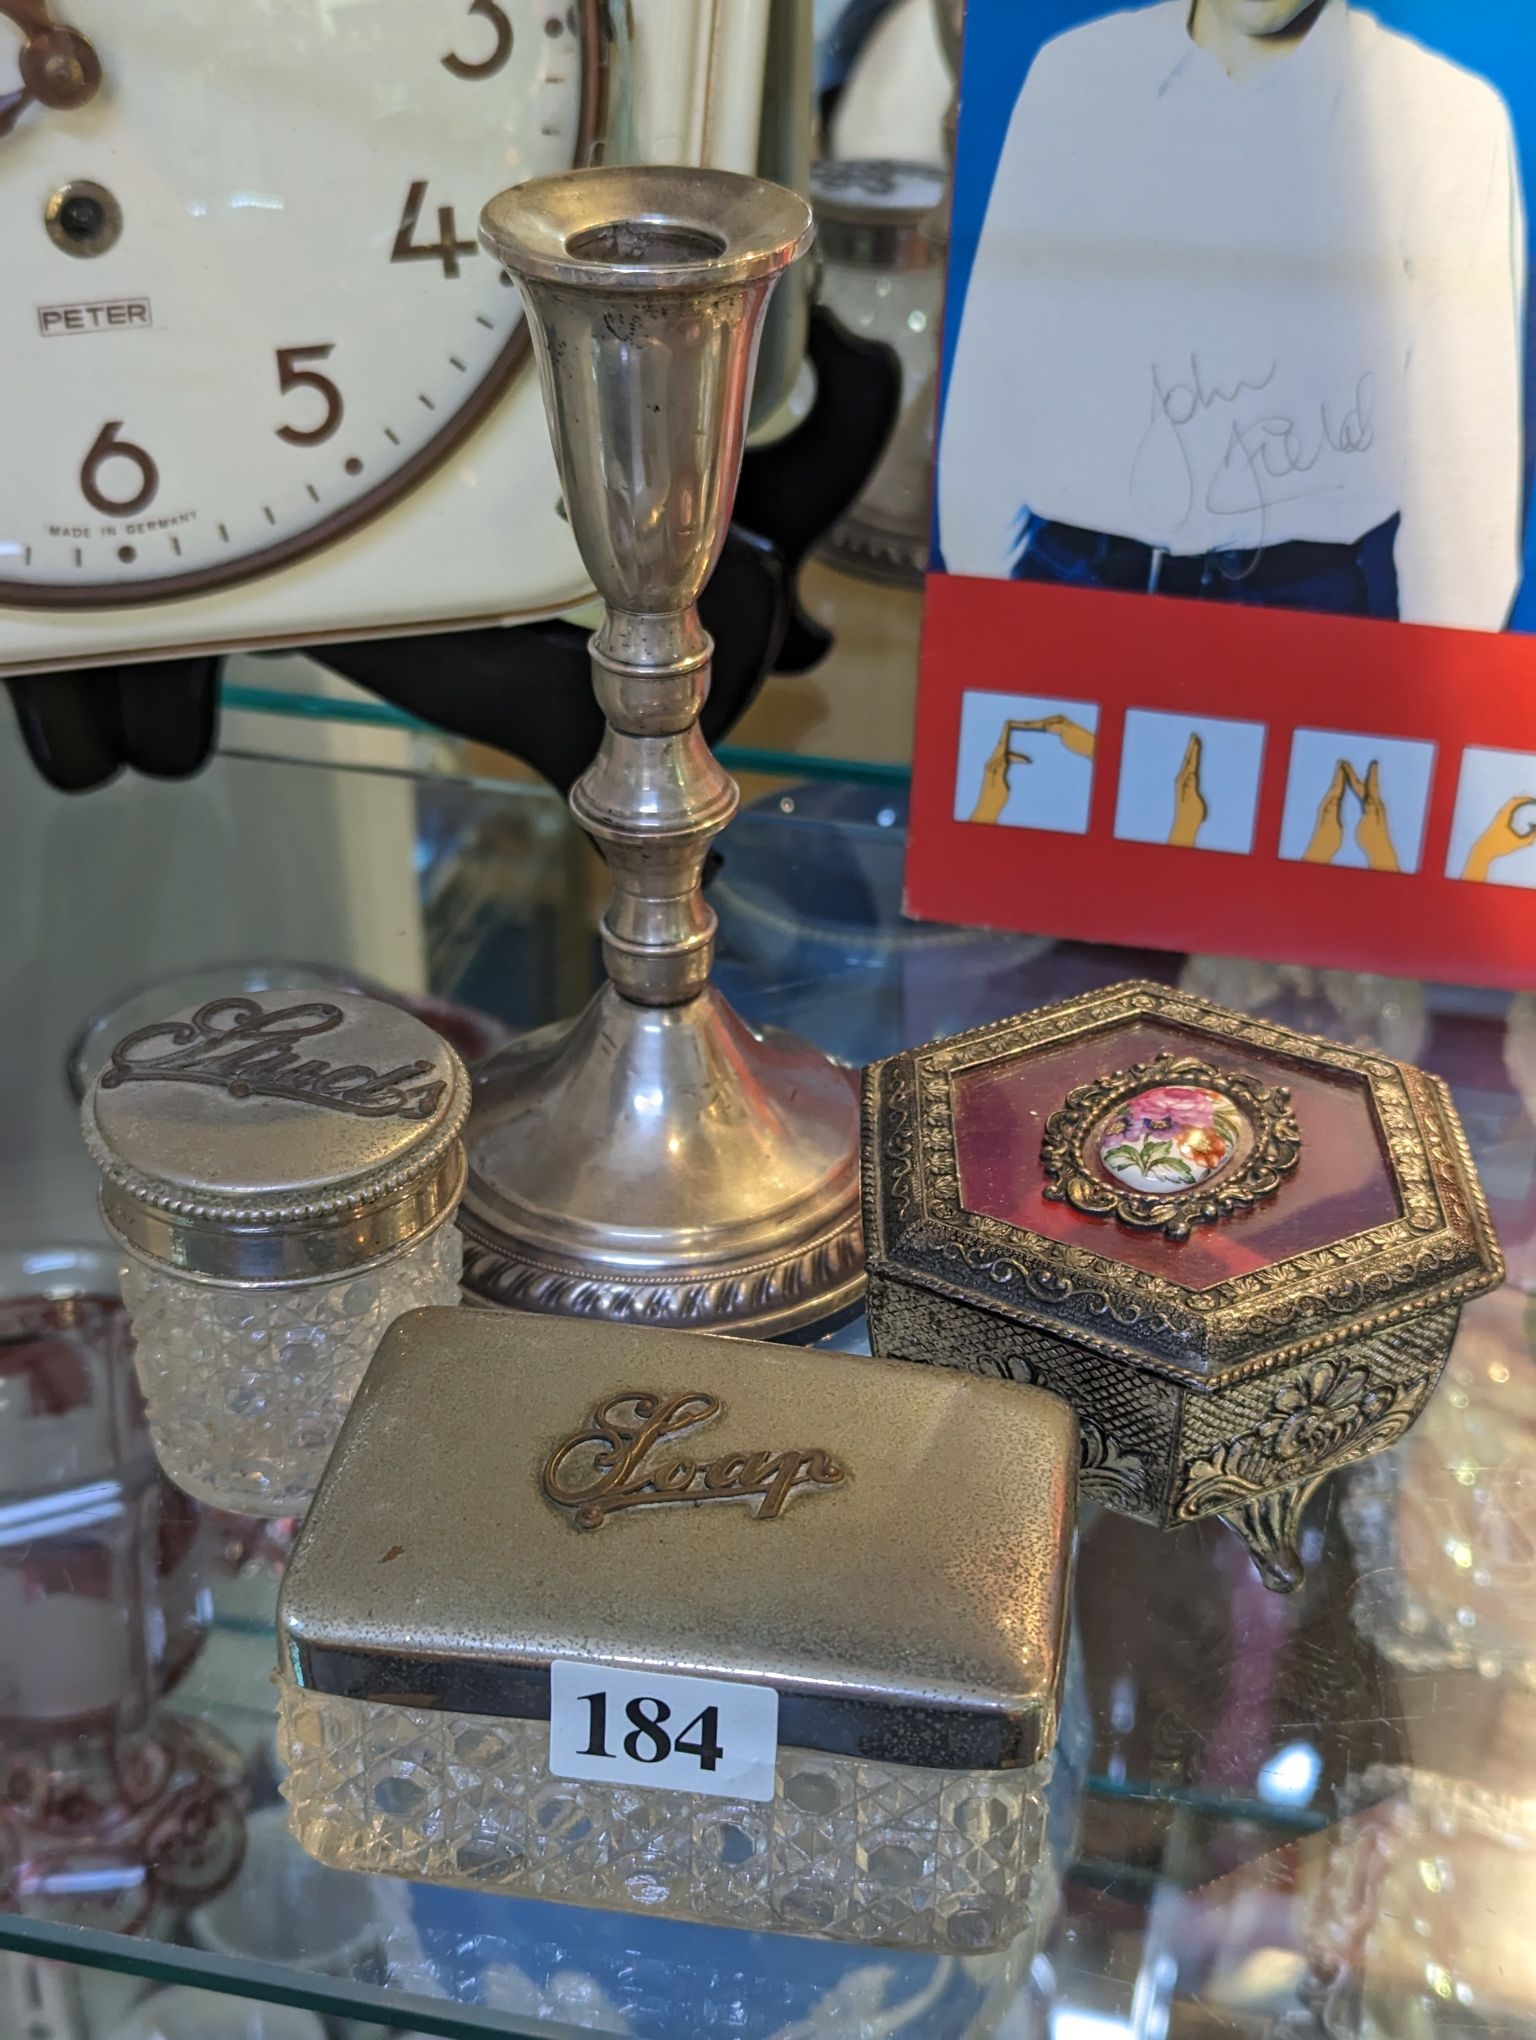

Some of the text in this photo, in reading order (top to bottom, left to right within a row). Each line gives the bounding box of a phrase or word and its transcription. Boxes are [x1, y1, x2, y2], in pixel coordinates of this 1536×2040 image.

[390, 181, 479, 279] 4
[42, 303, 147, 331] PETER
[275, 343, 344, 447] 5
[80, 421, 159, 517] 6
[49, 510, 197, 538] MADE IN GERMANY
[543, 1391, 846, 1529] Soap
[575, 1691, 724, 1772] 184
